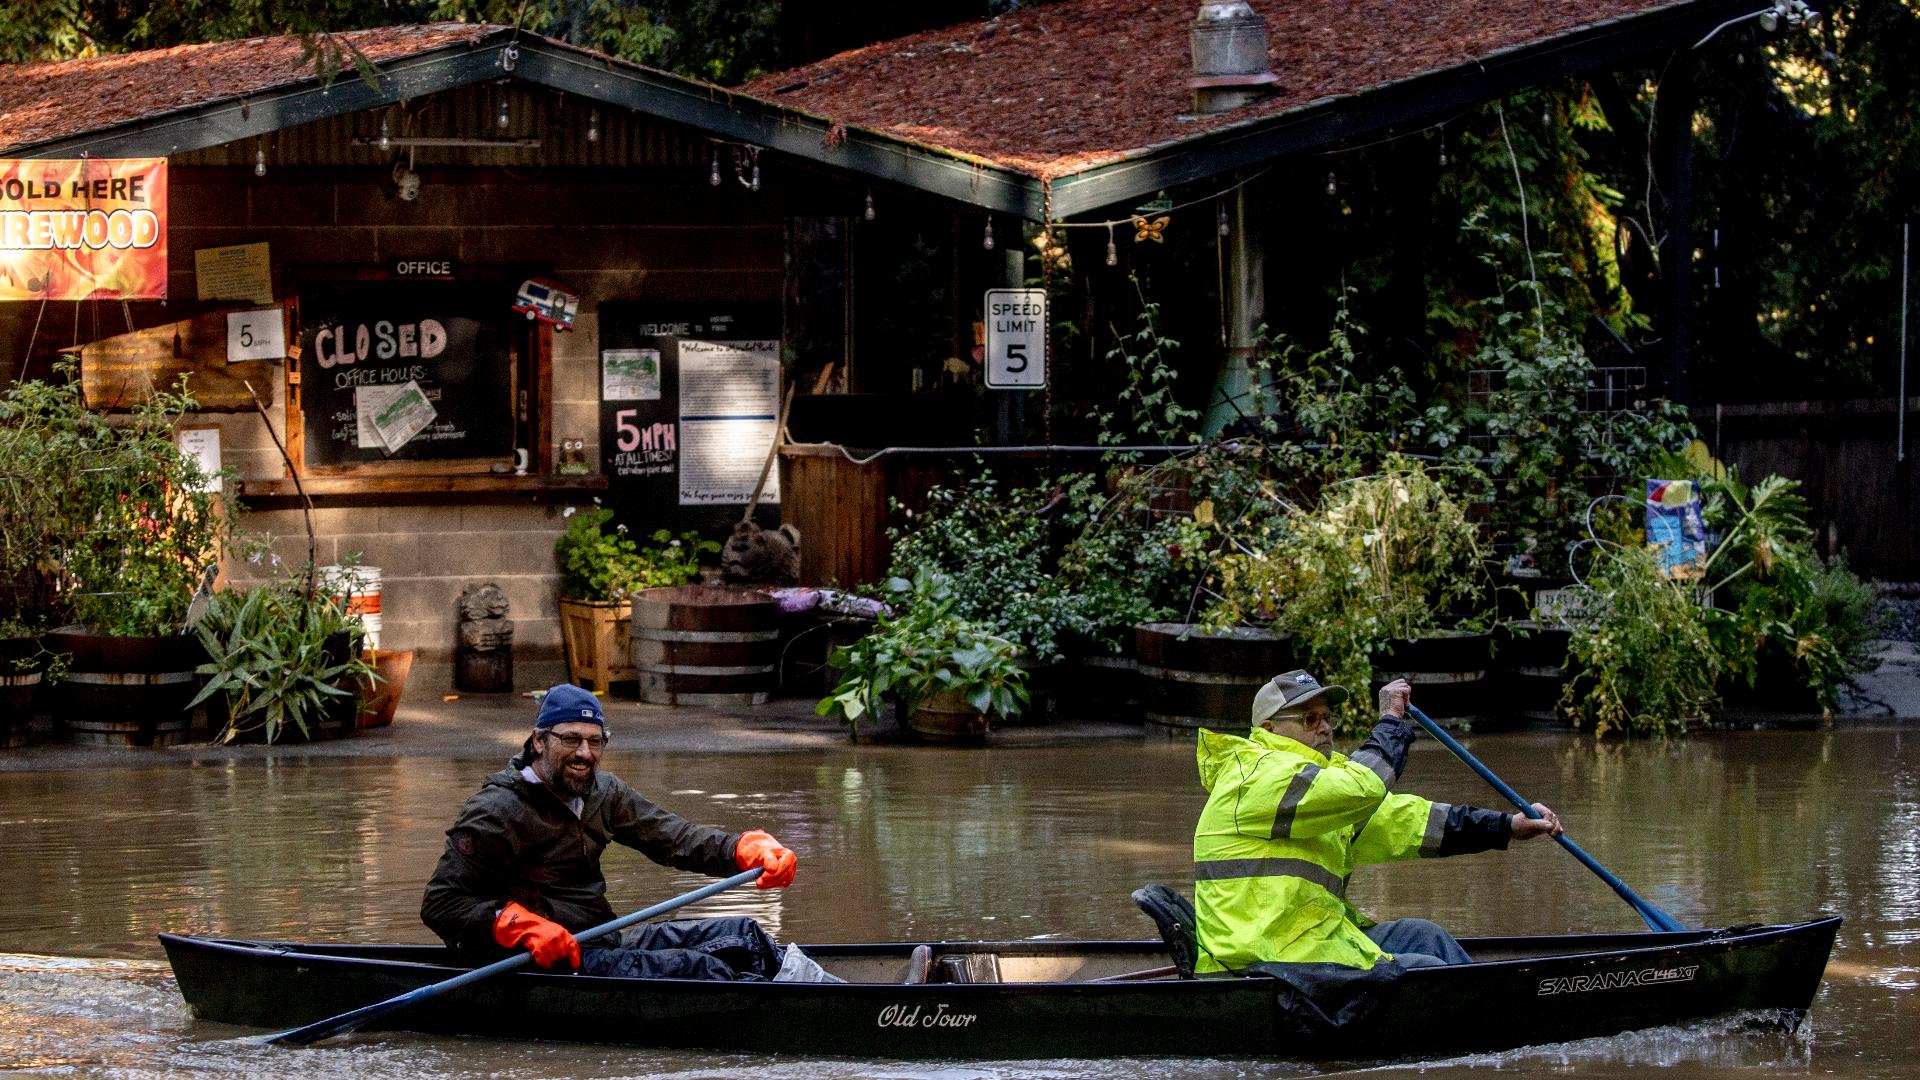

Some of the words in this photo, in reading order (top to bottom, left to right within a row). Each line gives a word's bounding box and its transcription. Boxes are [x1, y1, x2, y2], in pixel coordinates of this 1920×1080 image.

[0, 178, 61, 201] OLD
[71, 176, 145, 201] HERE
[397, 261, 450, 275] OFFICE
[992, 304, 1042, 316] SPEED
[240, 324, 253, 348] 5
[640, 323, 690, 336] WELCOME
[997, 320, 1036, 333] LIMIT
[315, 319, 447, 368] CLOSED
[1006, 344, 1028, 373] 5
[335, 368, 377, 388] OFFICE
[616, 409, 641, 452] 5
[641, 422, 677, 451] MPH
[615, 452, 626, 466] AT
[626, 451, 643, 466] ALL
[1538, 968, 1655, 996] SARANAC
[877, 1003, 920, 1028] Old
